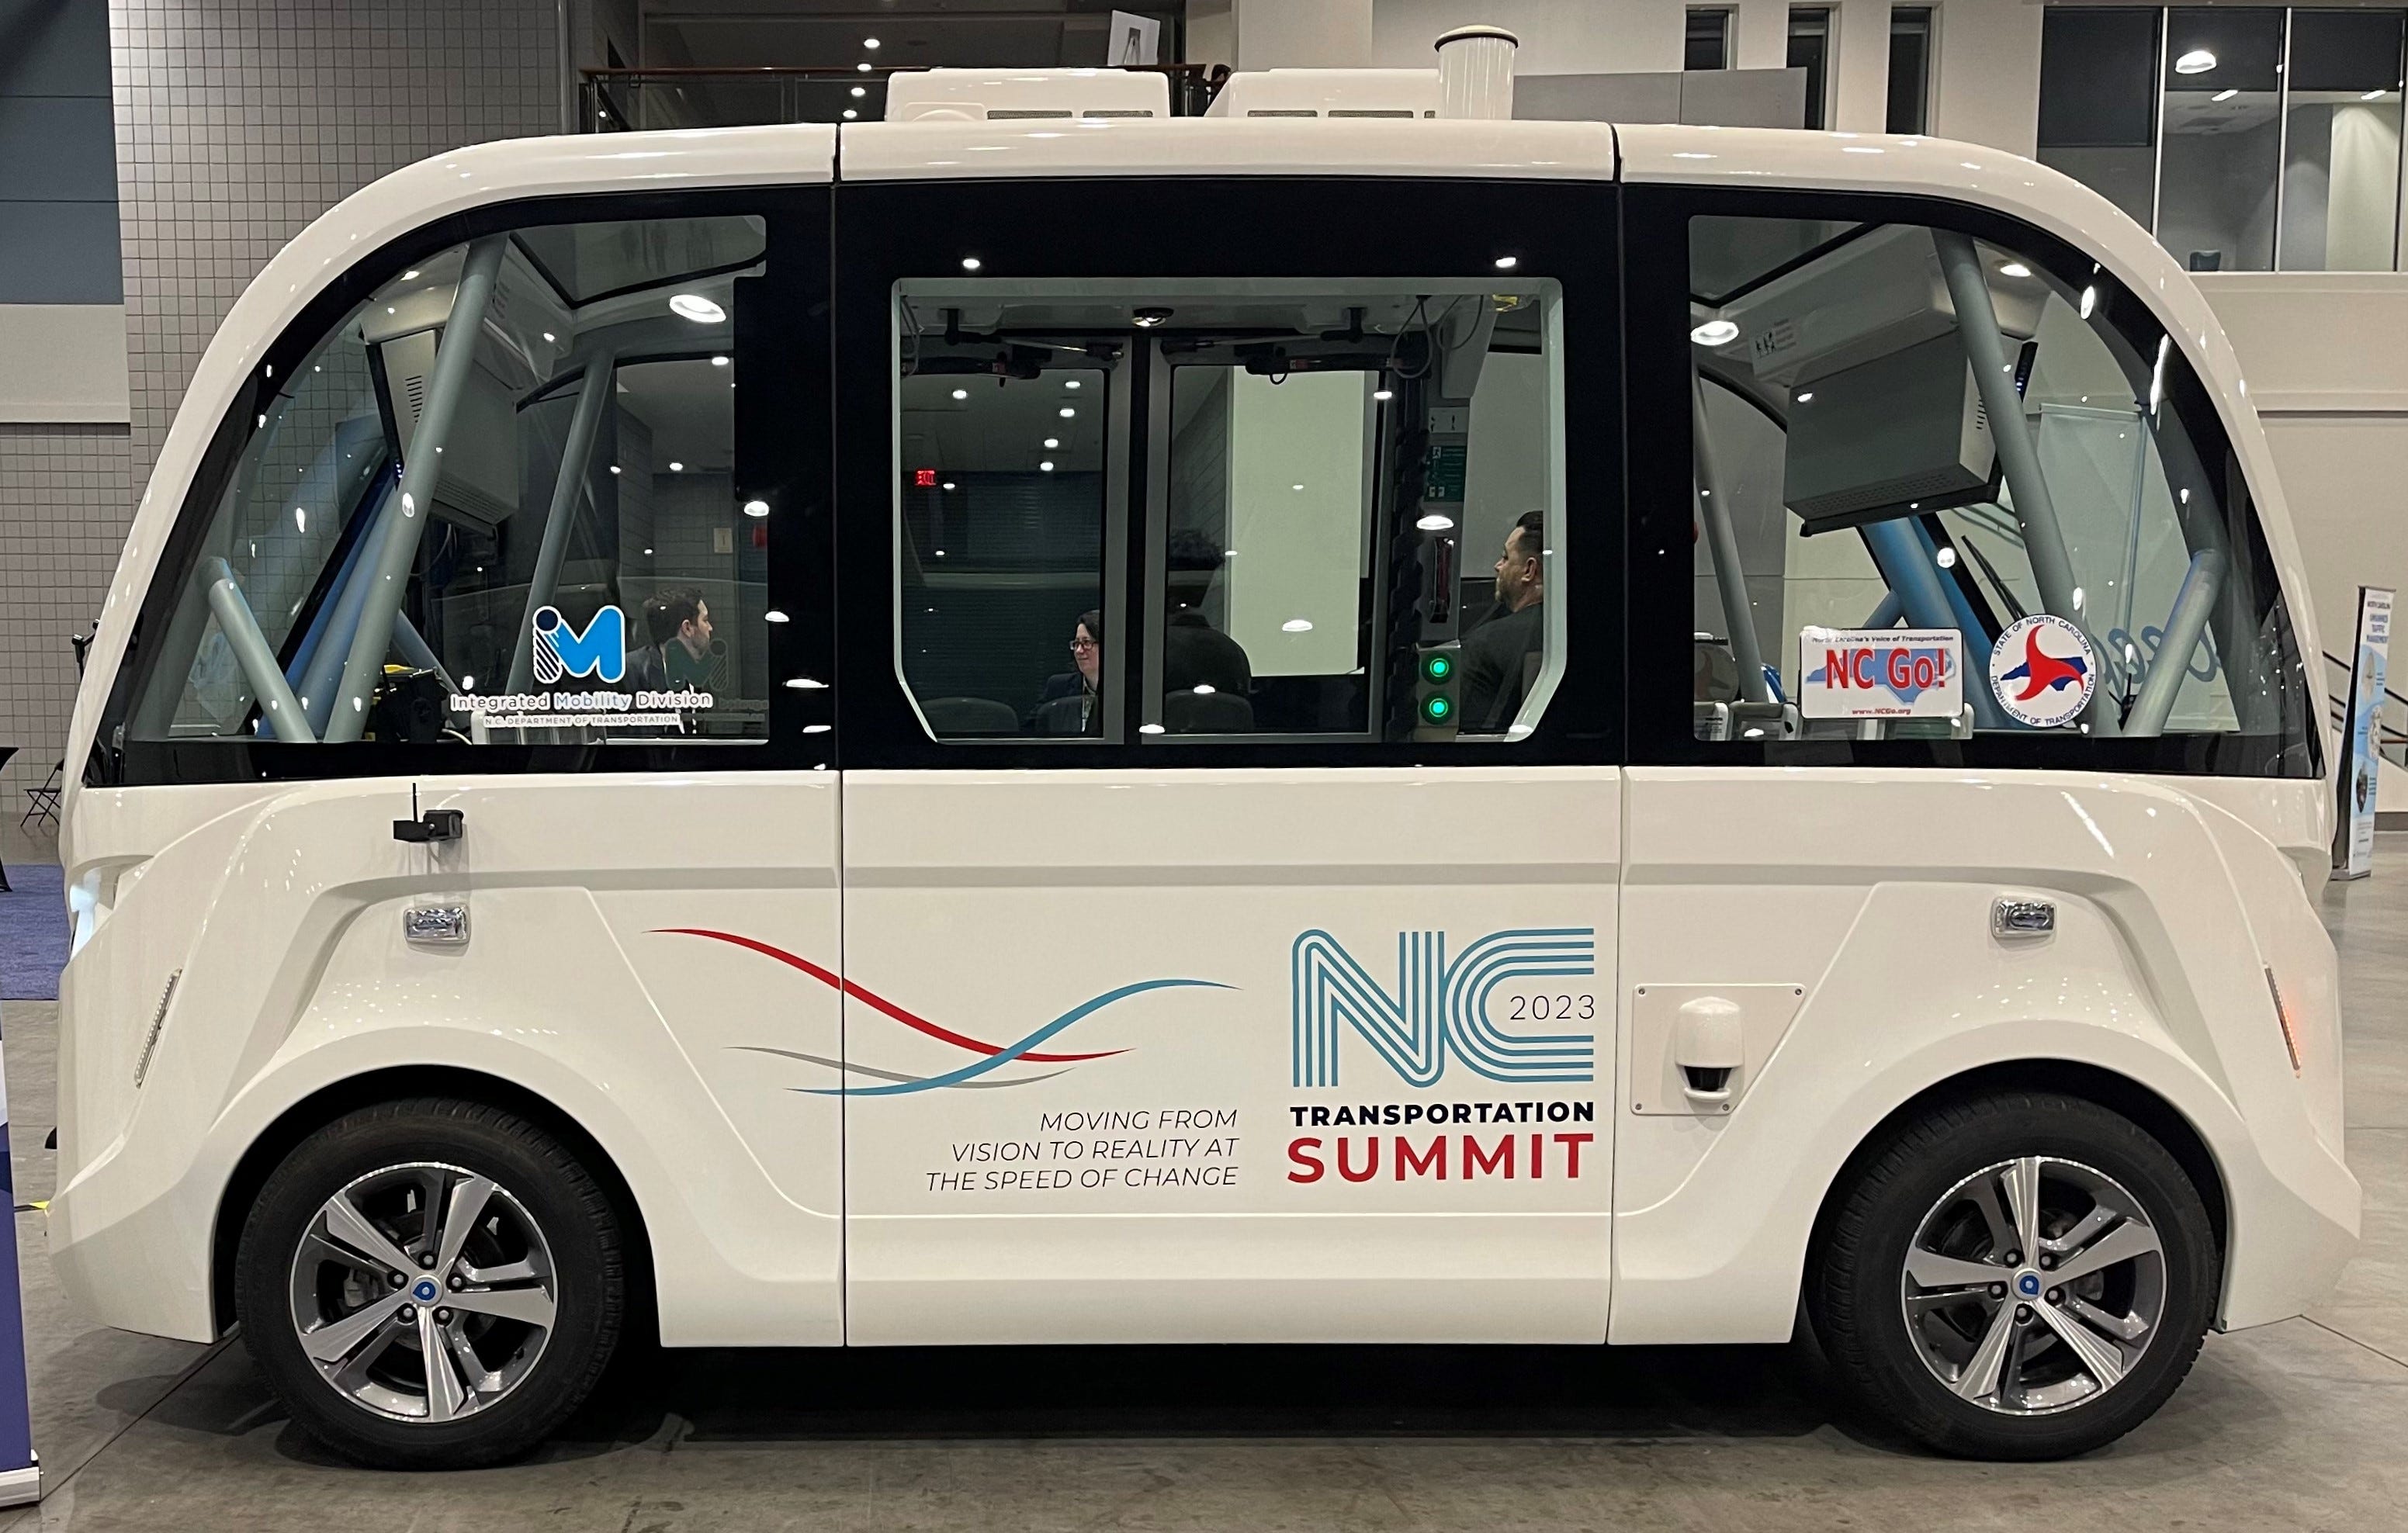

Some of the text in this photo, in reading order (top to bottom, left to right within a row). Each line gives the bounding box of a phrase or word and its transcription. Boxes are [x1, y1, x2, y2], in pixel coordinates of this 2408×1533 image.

[1994, 616, 2091, 656] STATE OF NORTH CAROLINA
[1826, 647, 1945, 690] NC Go!
[452, 692, 711, 711] Integrated Mobility Division
[2044, 673, 2095, 725] TRANSPORTATION
[507, 717, 571, 725] DEPARTMENT
[591, 715, 678, 724] TRANSPORTATION
[1292, 928, 1595, 1088] NC
[1509, 994, 1596, 1020] 2023
[1041, 1109, 1238, 1131] MOVING FROM
[1290, 1101, 1594, 1126] TRANSPORTATION
[952, 1137, 1240, 1161] VISION TO REALITY AT
[1287, 1133, 1594, 1183] SUMMIT
[926, 1167, 1239, 1192] THE SPEED OF CHANGE
